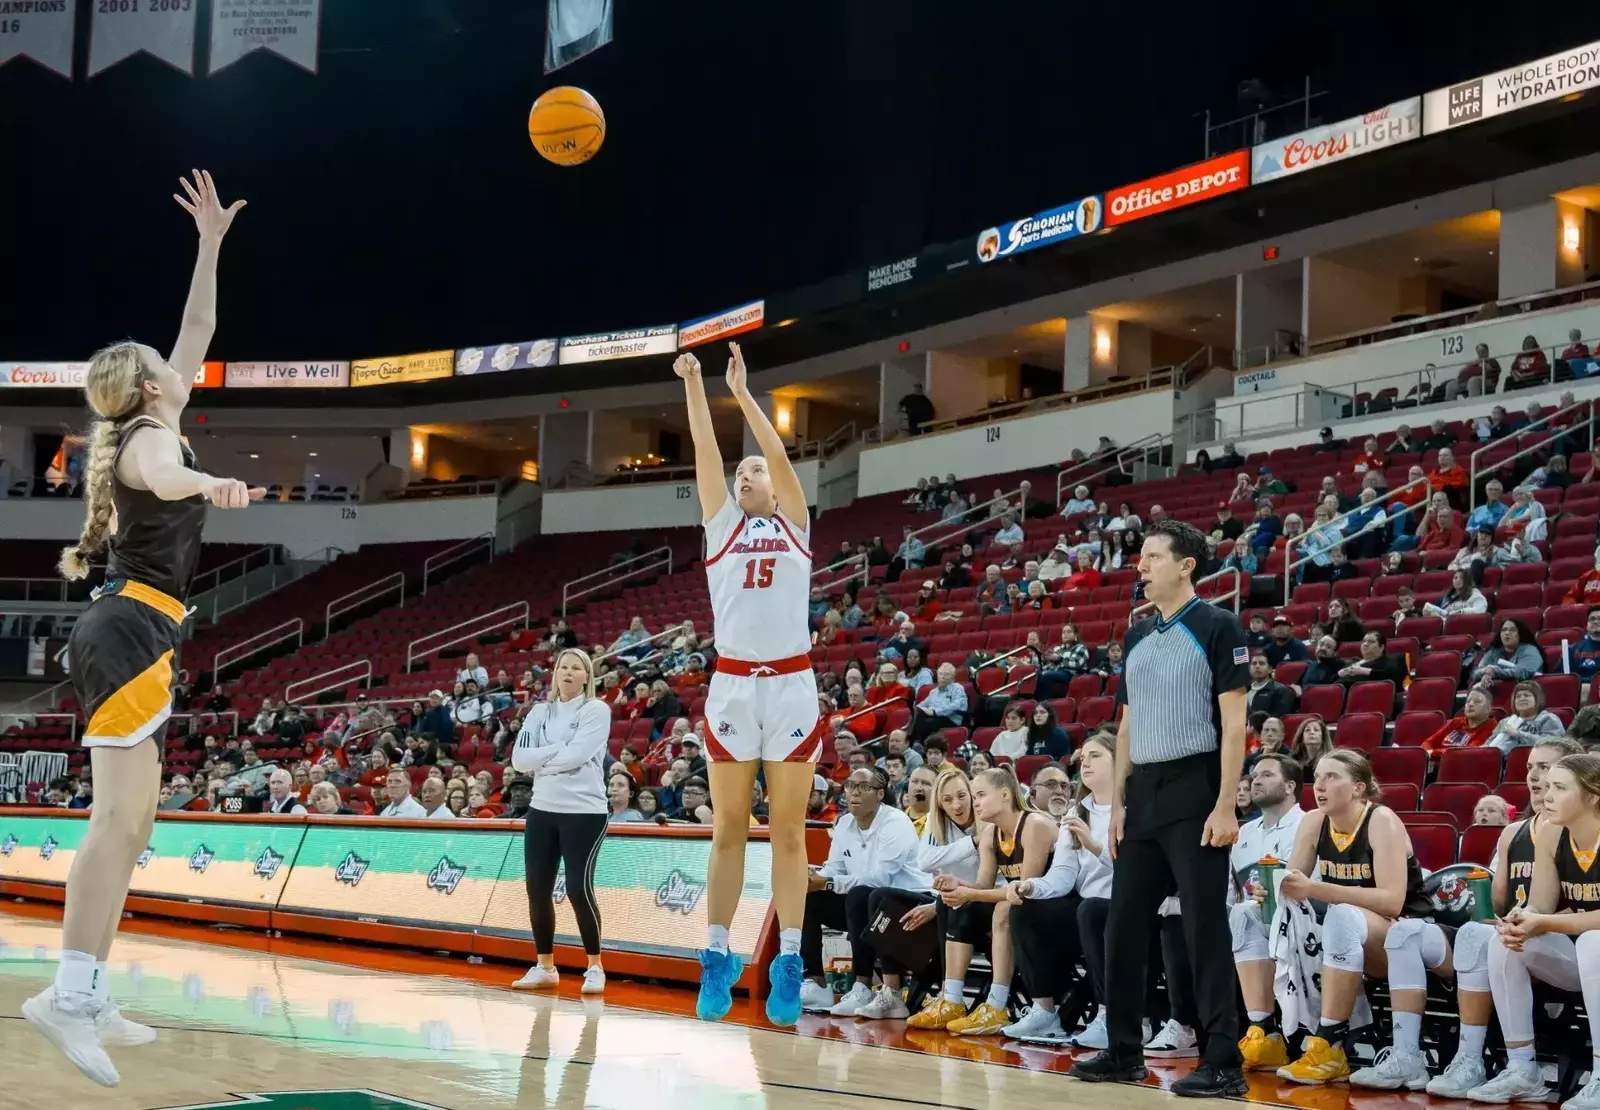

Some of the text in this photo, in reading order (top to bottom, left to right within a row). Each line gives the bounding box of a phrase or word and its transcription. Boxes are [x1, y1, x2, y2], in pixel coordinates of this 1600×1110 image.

[98, 0, 139, 13] 2001
[1497, 47, 1600, 89] WHOLE BODY
[1497, 64, 1600, 107] HYDRATION
[1451, 86, 1480, 105] LIFE
[1451, 101, 1480, 119] WTR
[1284, 114, 1417, 169] Coors LIGHT
[1111, 166, 1240, 216] Office DEPOT
[1022, 210, 1075, 235] SIMONIAN
[868, 257, 917, 281] MAKE MORE
[868, 269, 913, 291] MEMORIES.
[564, 327, 673, 346] Purchase Tickets From
[1441, 335, 1464, 356] 123
[588, 342, 648, 357] ticketmaster
[11, 365, 57, 383] Coors
[60, 371, 82, 384] LIG
[266, 363, 298, 378] Live
[304, 363, 339, 378] Well
[1238, 370, 1276, 384] COCKTAILS
[986, 426, 1000, 442] 124
[676, 485, 691, 499] 125
[341, 507, 357, 520] 126
[743, 558, 776, 589] 15
